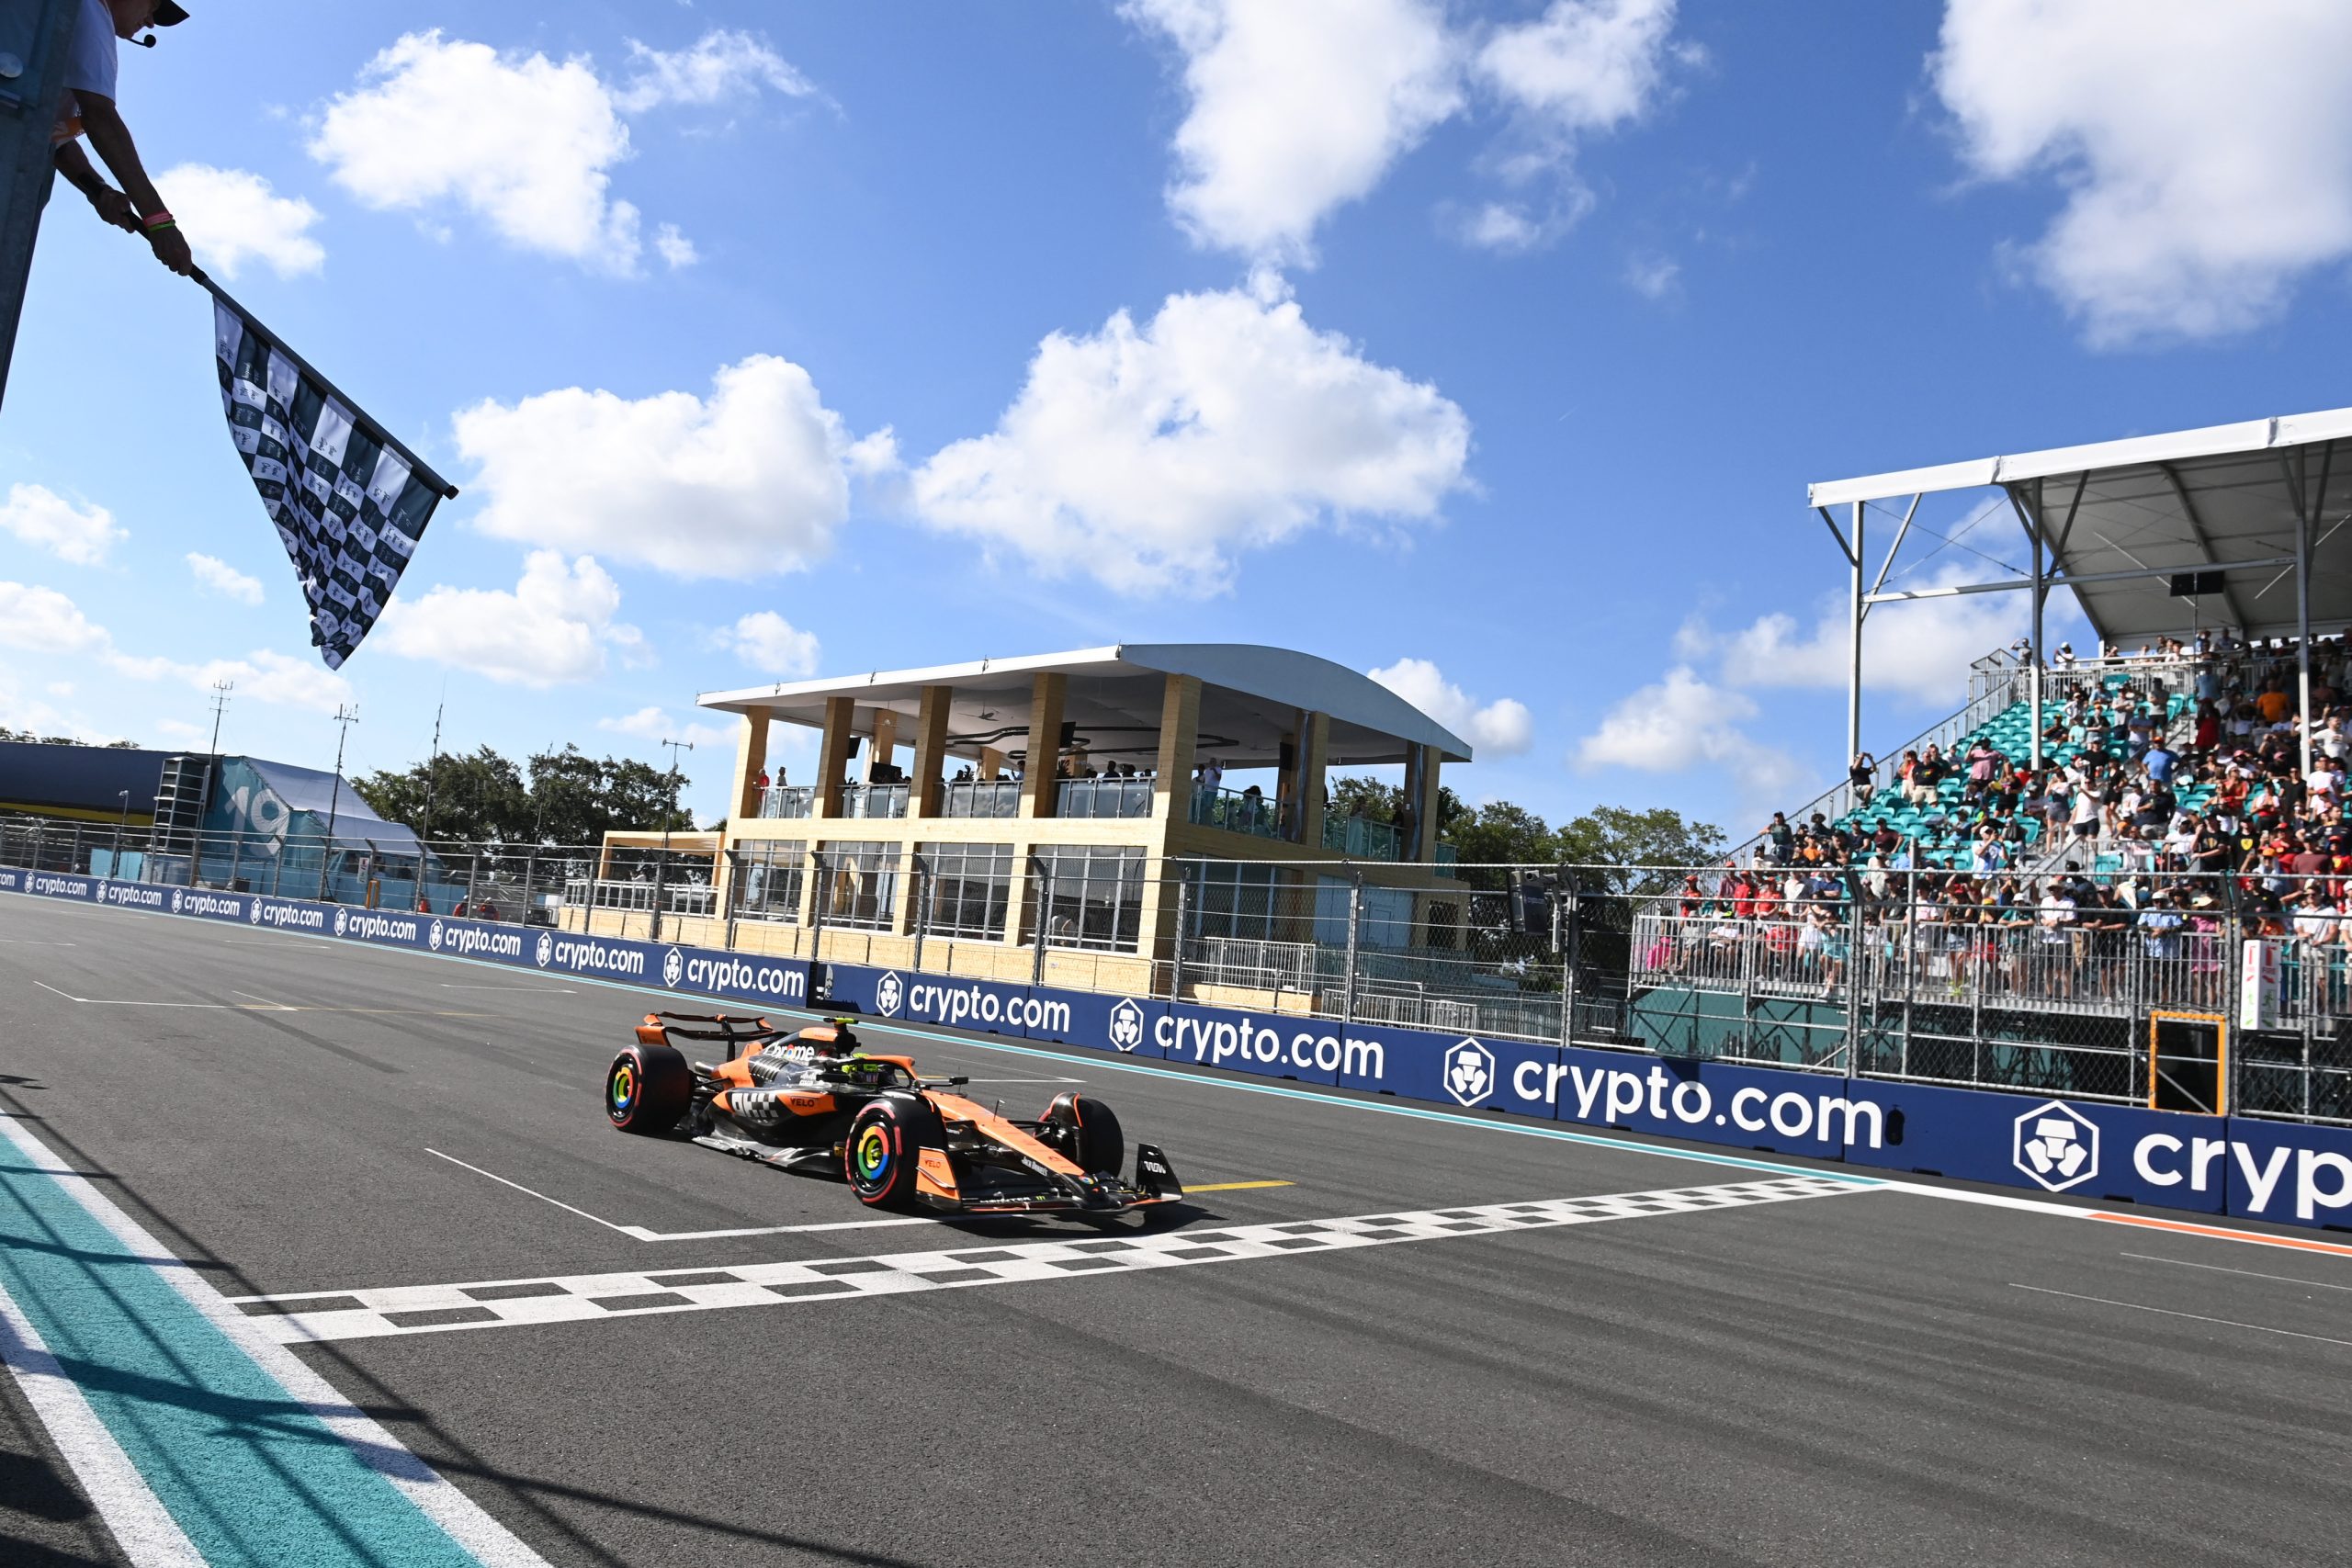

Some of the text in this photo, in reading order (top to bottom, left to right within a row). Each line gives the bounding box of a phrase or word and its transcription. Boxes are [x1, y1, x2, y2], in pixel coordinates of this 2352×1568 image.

[37, 878, 87, 896] crypto.com
[108, 886, 163, 905] crypto.com
[185, 895, 241, 916] crypto.com
[264, 904, 323, 928] crypto.com
[350, 916, 417, 941] crypto.com
[446, 928, 522, 956] crypto.com
[556, 942, 643, 975] crypto.com
[688, 959, 805, 997] crypto.com
[910, 984, 1070, 1032] crypto.com
[763, 1041, 815, 1062] Chrome
[1154, 1016, 1385, 1079] crypto.com
[790, 1097, 815, 1108] VELO
[1514, 1061, 1883, 1149] crypto.com
[924, 1159, 942, 1168] VELO
[2133, 1134, 2352, 1220] cryp
